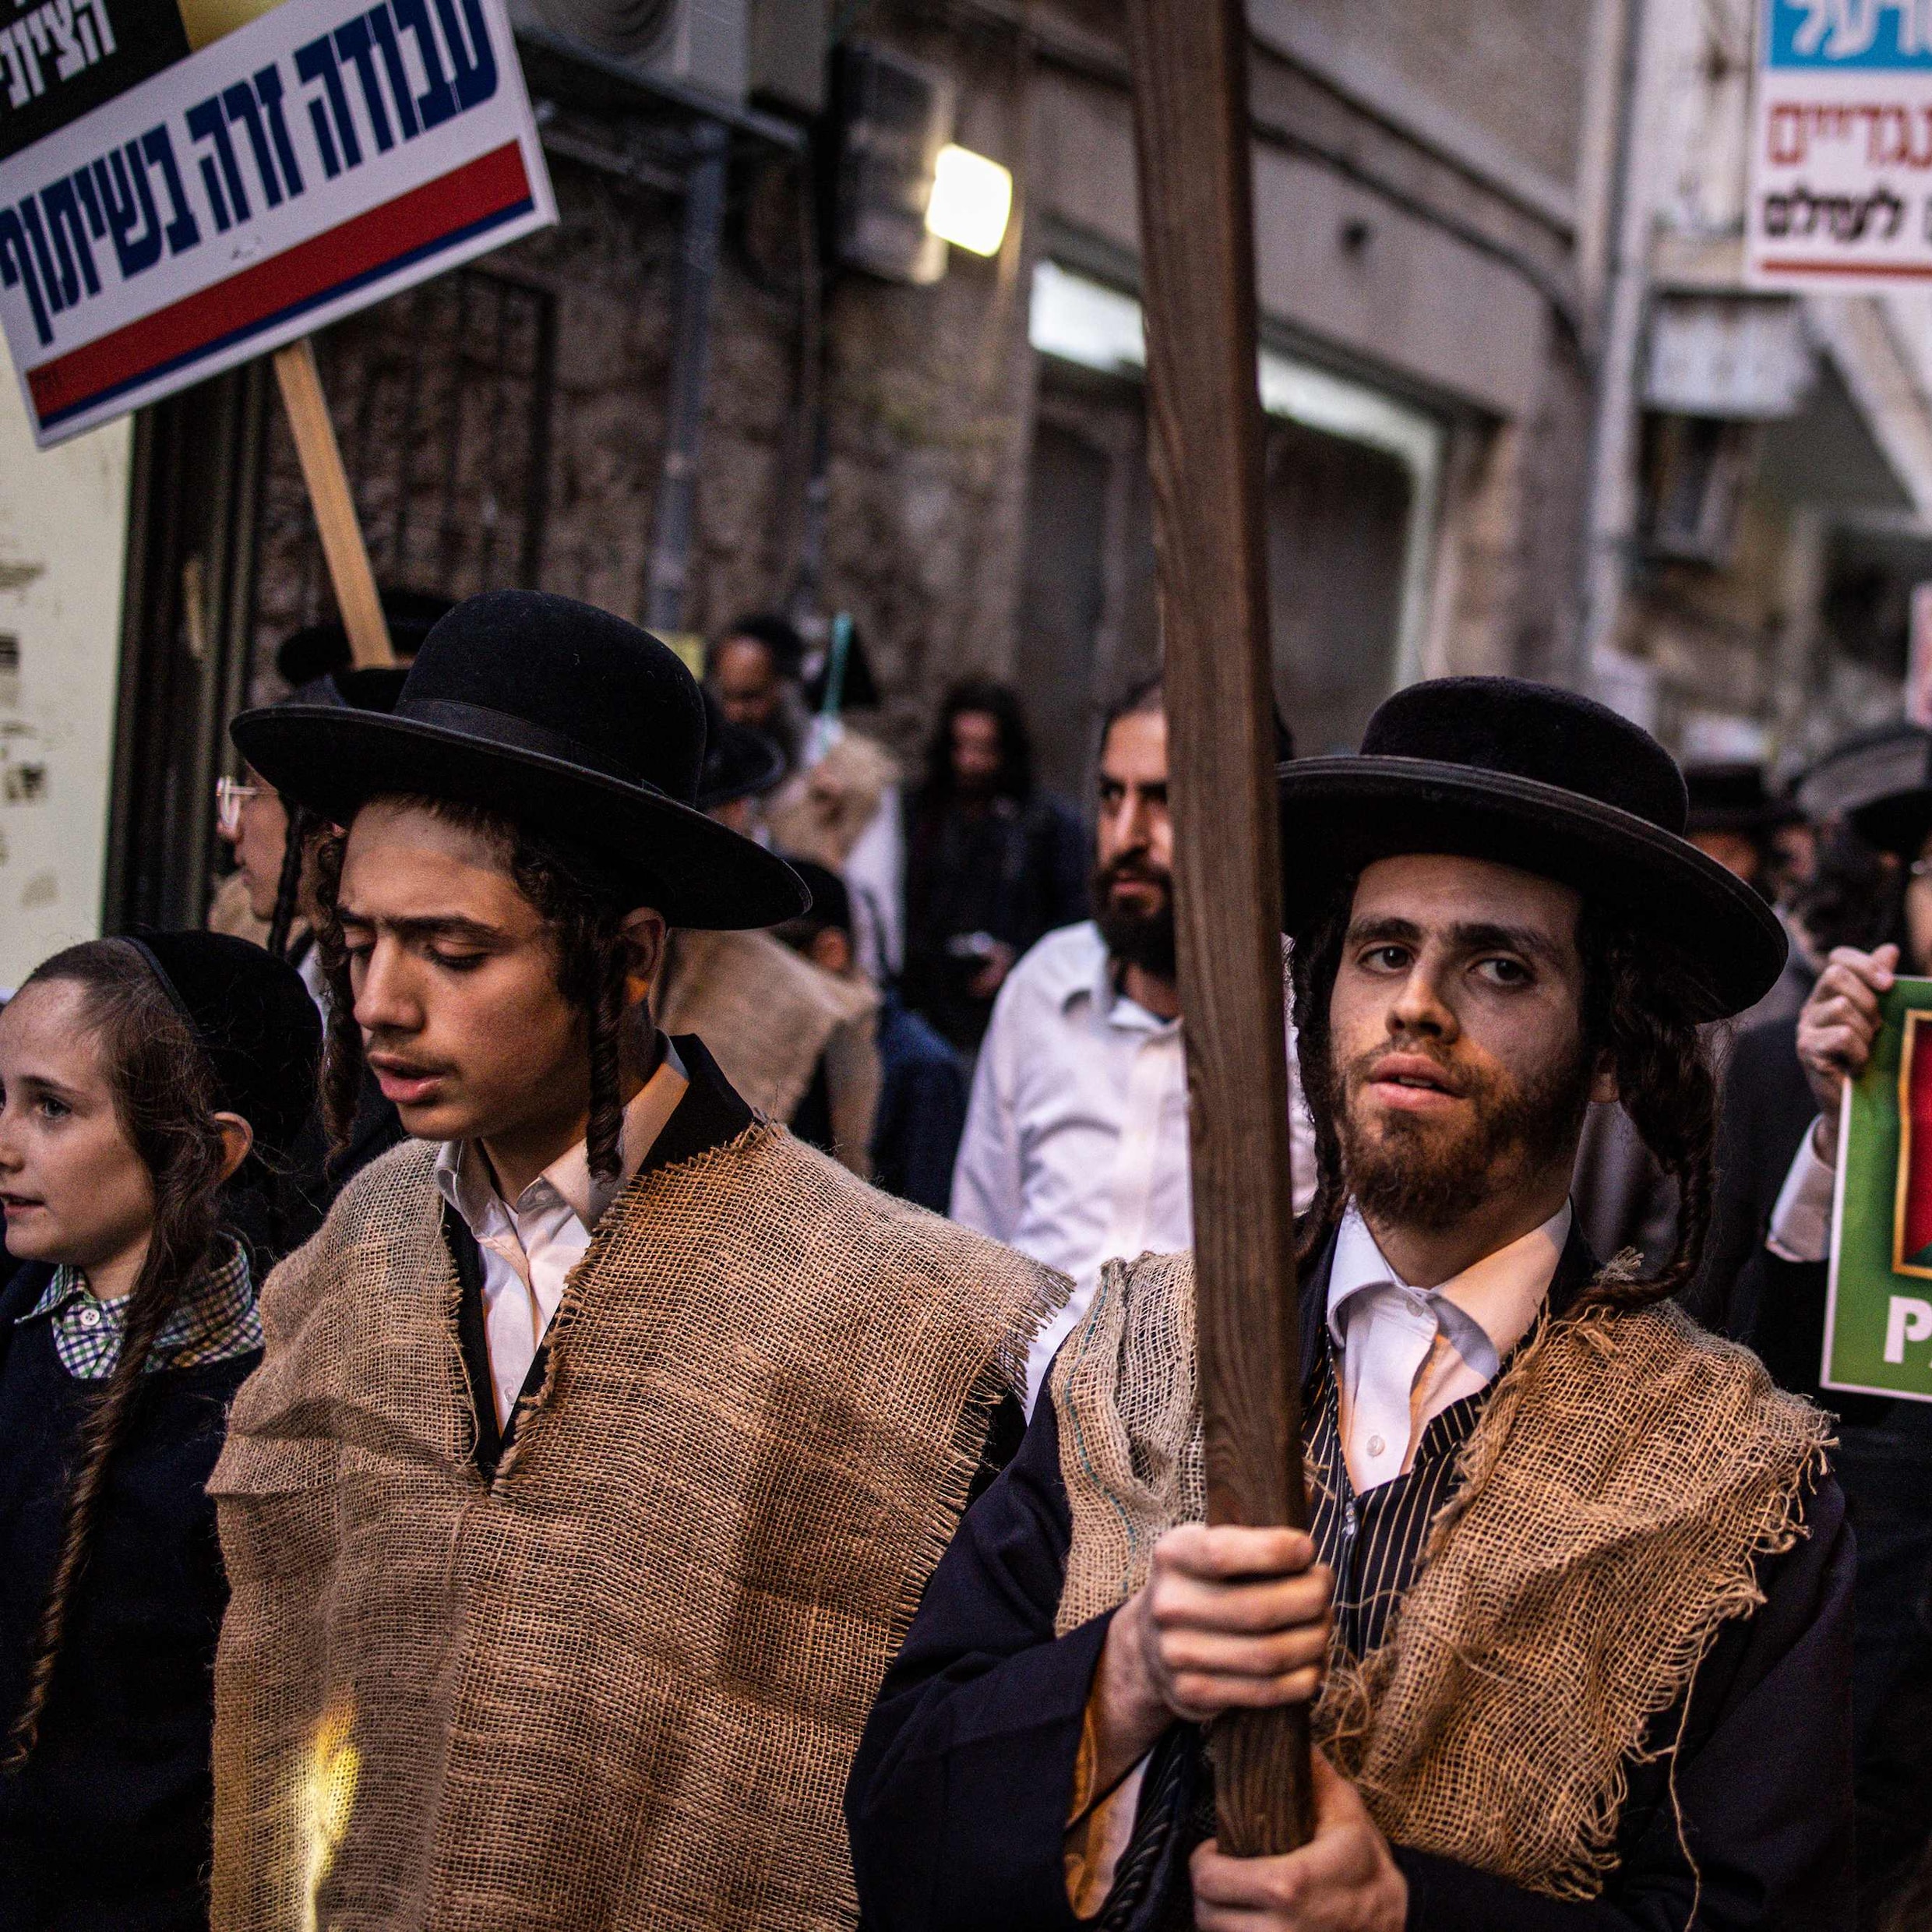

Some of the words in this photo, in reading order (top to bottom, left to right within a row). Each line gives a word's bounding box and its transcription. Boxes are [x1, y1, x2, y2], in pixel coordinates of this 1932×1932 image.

[0, 0, 116, 109] הציונ
[294, 0, 499, 182] עבודה
[185, 62, 305, 234] זרה
[0, 122, 201, 349] בשיתוף
[1883, 1295, 1932, 1370] P
